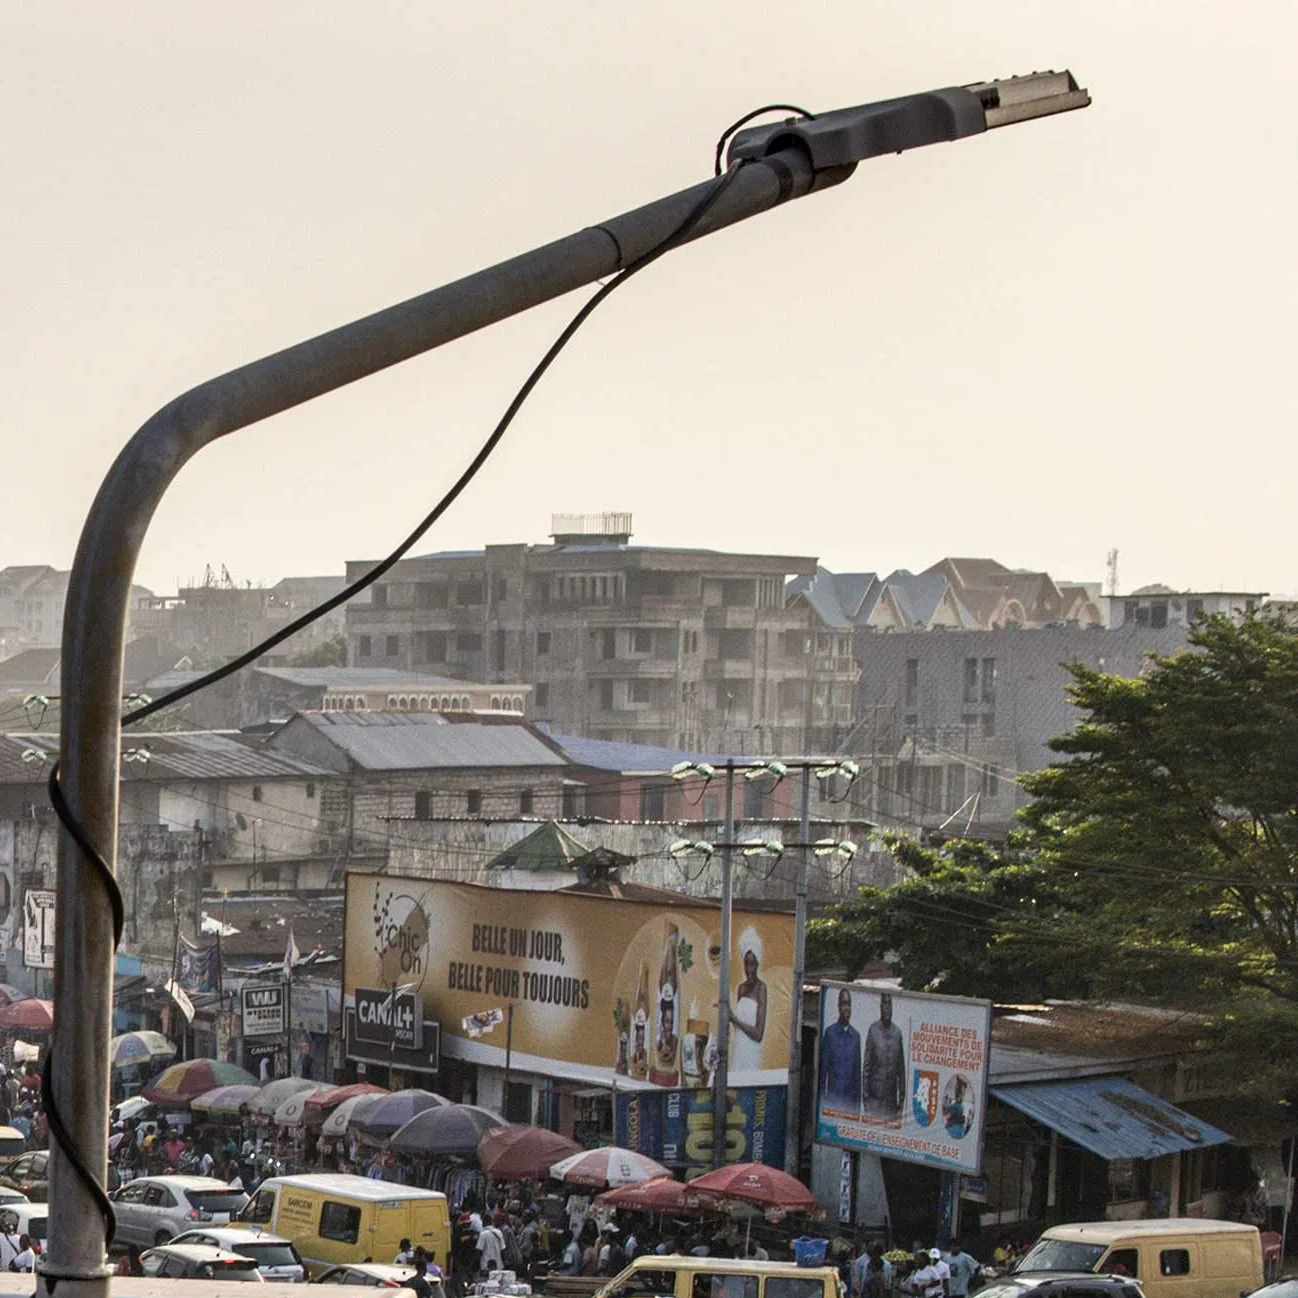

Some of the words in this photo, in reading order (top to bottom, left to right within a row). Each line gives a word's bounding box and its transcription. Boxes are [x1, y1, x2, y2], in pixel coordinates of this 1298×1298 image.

[387, 925, 422, 950] Chic
[473, 923, 508, 955] BELLE
[510, 929, 526, 957] UN
[529, 930, 565, 966] JOUR,
[448, 961, 483, 994] BELLE
[485, 966, 520, 1000] POUR
[522, 971, 590, 1009] TOUJOURS
[251, 990, 277, 1006] WU
[920, 1023, 959, 1037] ALLIANCE
[961, 1028, 977, 1040] DES
[912, 1032, 969, 1049] MOUVEMENTS
[924, 1054, 981, 1072] CHANGEMENT
[960, 1049, 982, 1063] POUR
